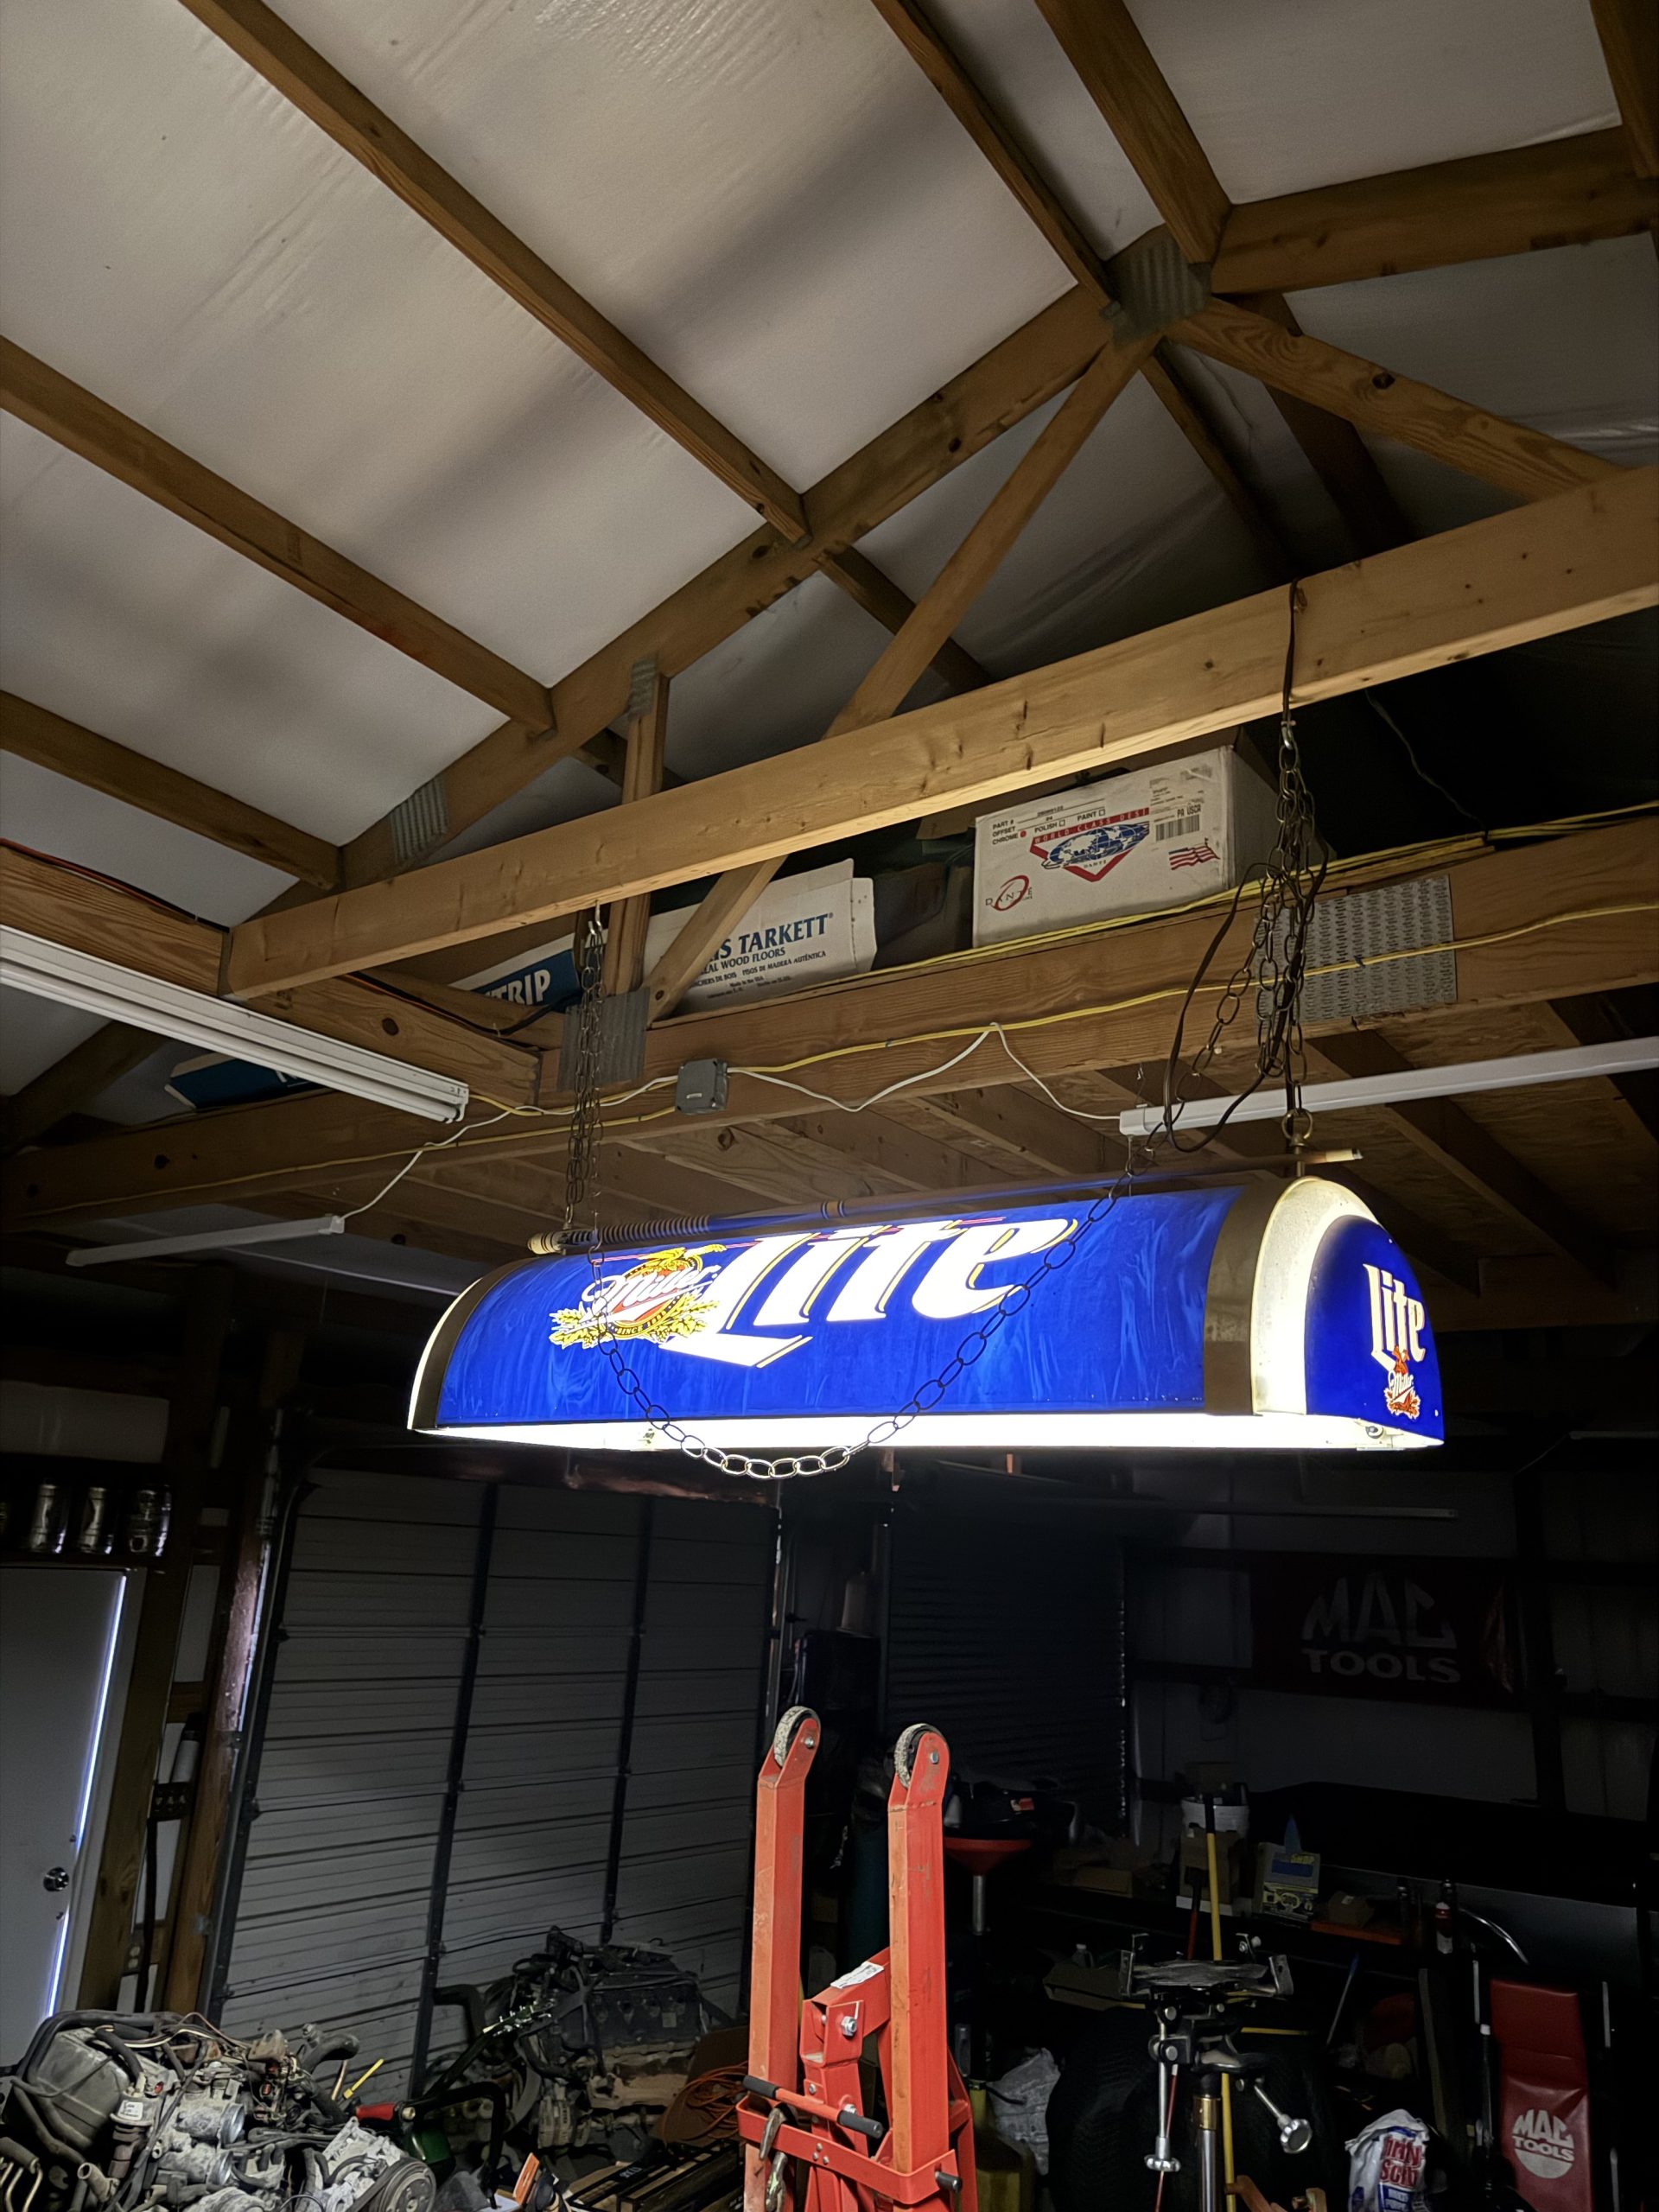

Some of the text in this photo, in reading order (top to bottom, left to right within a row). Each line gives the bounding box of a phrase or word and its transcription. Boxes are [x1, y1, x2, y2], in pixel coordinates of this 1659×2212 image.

[993, 821, 1008, 830] PART
[993, 811, 1096, 845] CHROME POLISH PAINT
[993, 826, 1015, 837] OFFSET
[1034, 830, 1070, 844] WORLD
[1077, 819, 1111, 832] CLASS
[1119, 810, 1146, 820] DESI
[739, 913, 829, 954] TARKETT
[721, 957, 750, 969] WOOD
[753, 947, 785, 963] FLOORS
[742, 966, 758, 976] PISOS
[767, 959, 792, 969] MADERA
[793, 950, 826, 963] AUTÉNTICA
[486, 969, 550, 1006] TRIP
[582, 1265, 721, 1319] Miller
[1301, 1571, 1458, 1649] MAC
[1301, 1647, 1462, 1684] TOOLS
[1513, 2109, 1574, 2149] MAC
[1512, 2135, 1574, 2161] TOOLS
